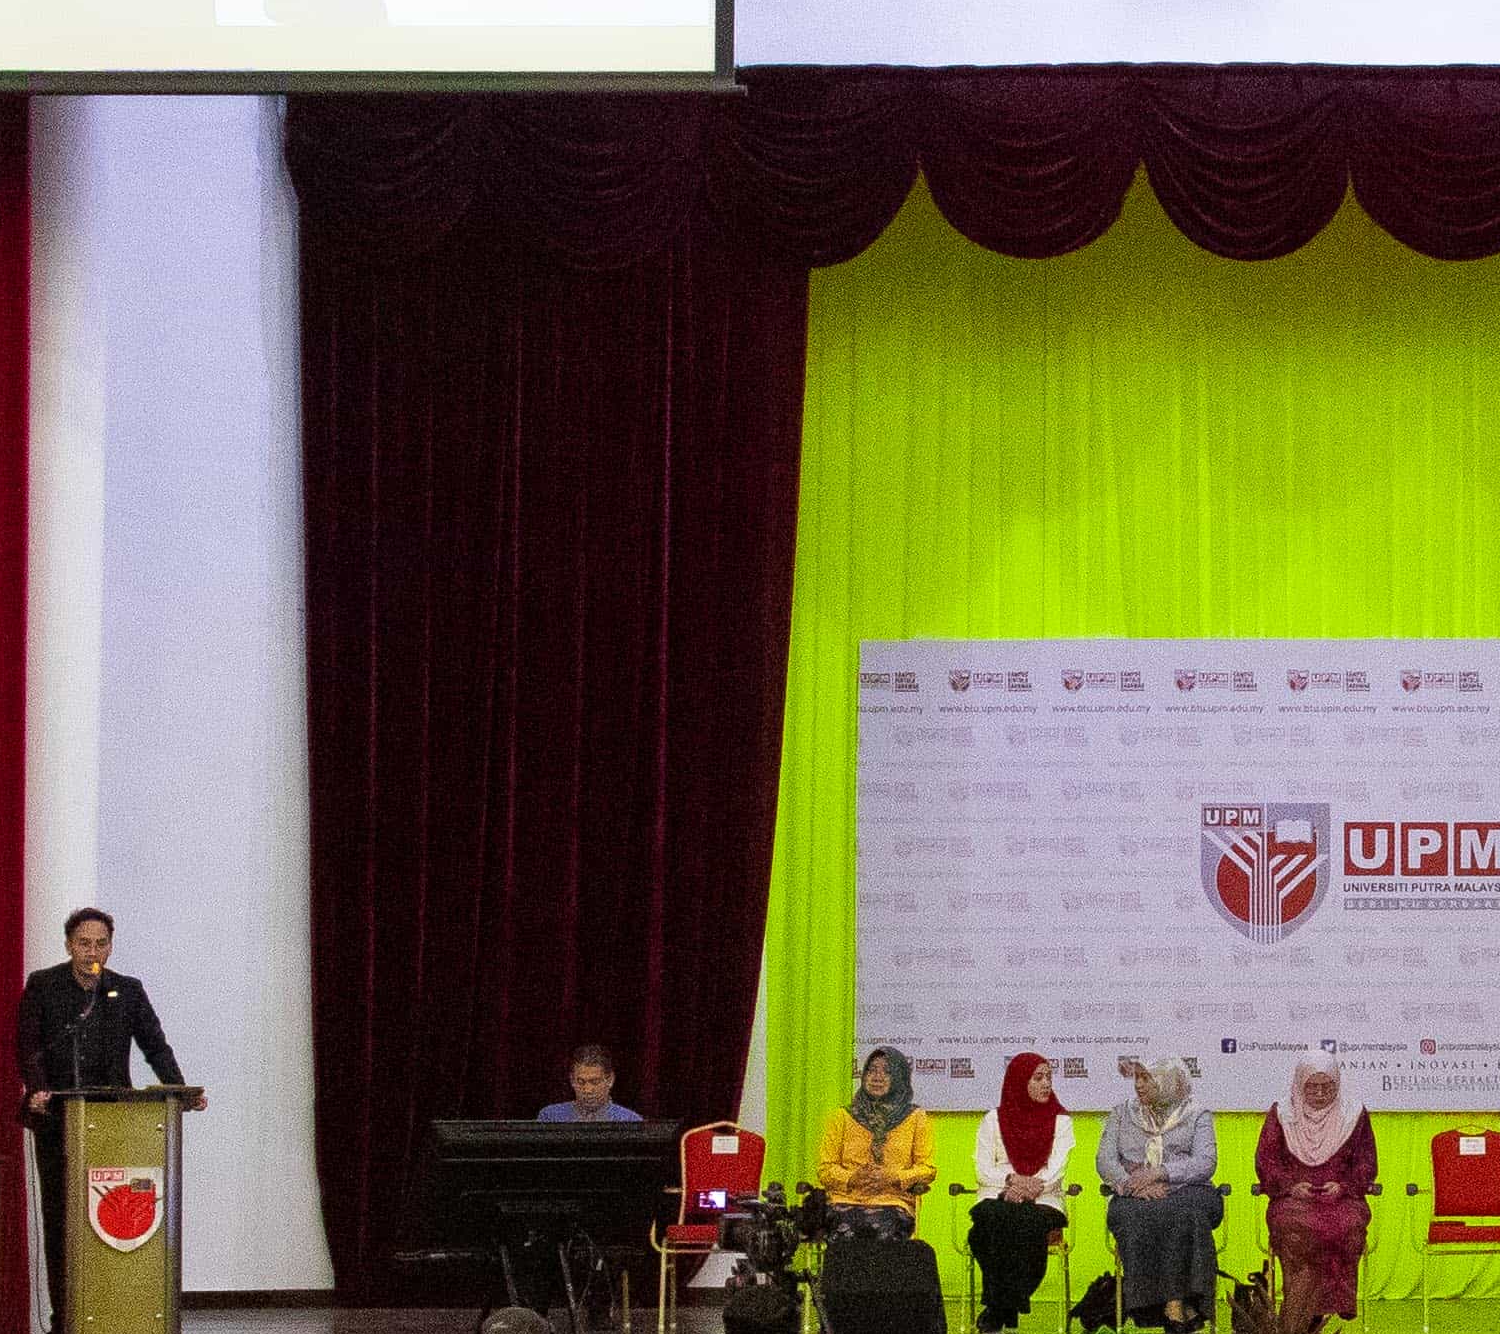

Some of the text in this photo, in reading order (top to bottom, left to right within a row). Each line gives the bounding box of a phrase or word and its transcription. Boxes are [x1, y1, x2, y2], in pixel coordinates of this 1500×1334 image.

[1204, 808, 1262, 826] UPM
[1343, 882, 1408, 893] UNIVERSITI
[1411, 882, 1451, 893] PUTRA
[1340, 1060, 1388, 1070] ANIAN
[1410, 1060, 1475, 1070] INOVASI
[91, 1169, 125, 1182] UPM
